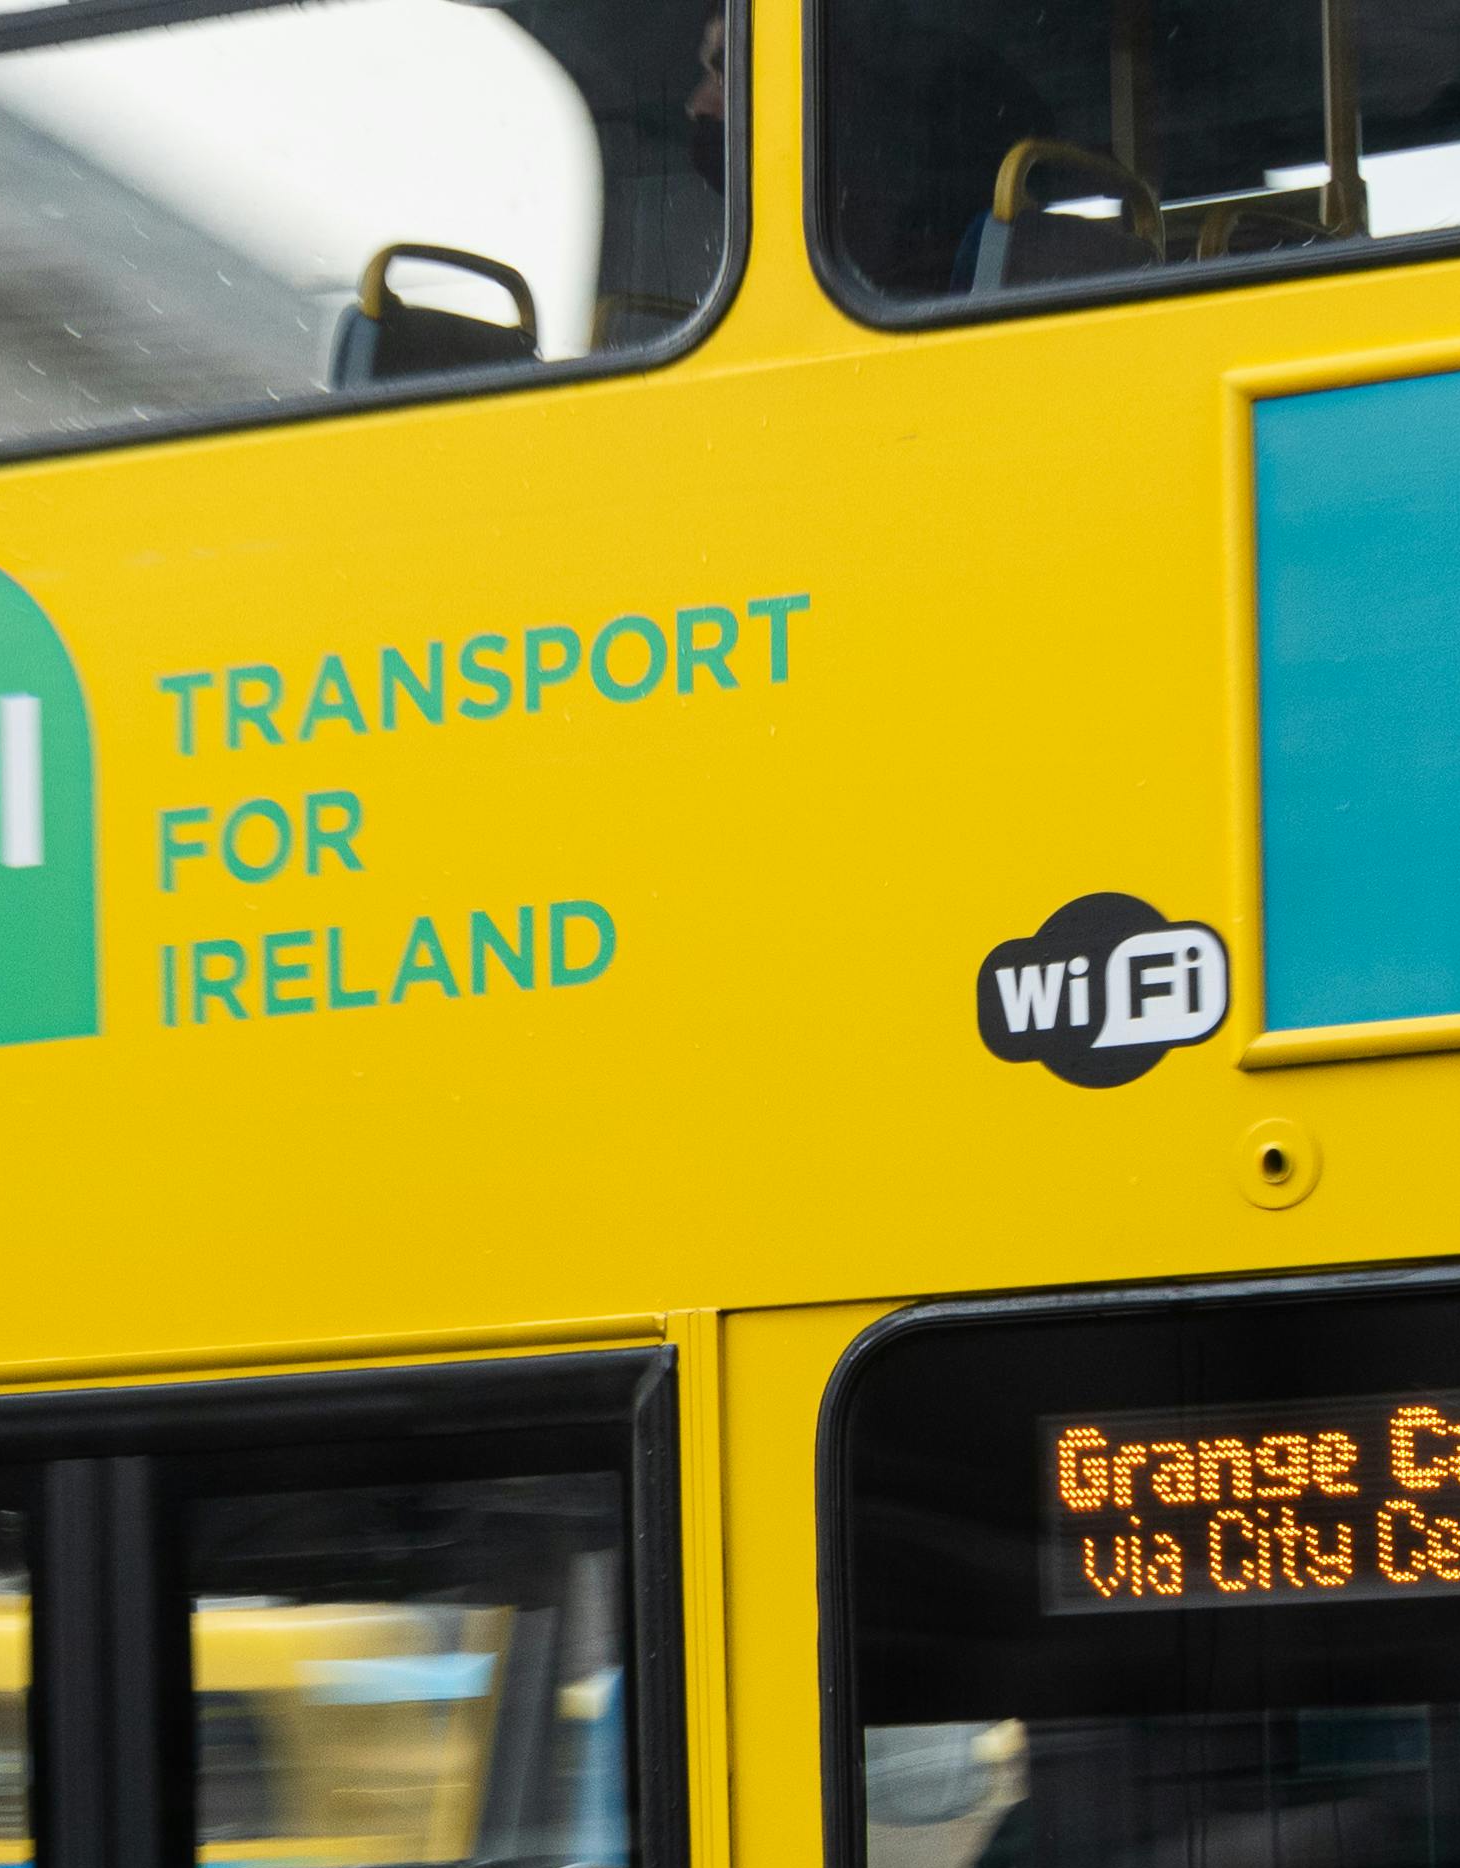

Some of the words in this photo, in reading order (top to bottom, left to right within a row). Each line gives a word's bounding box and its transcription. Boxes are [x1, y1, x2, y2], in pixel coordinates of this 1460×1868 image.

[159, 592, 814, 758] TRANSPORT
[158, 789, 368, 894] FOR
[159, 898, 619, 1029] IRELAND
[1056, 1427, 1359, 1513] Grange
[1083, 1515, 1183, 1598] via
[1209, 1506, 1353, 1591] City
